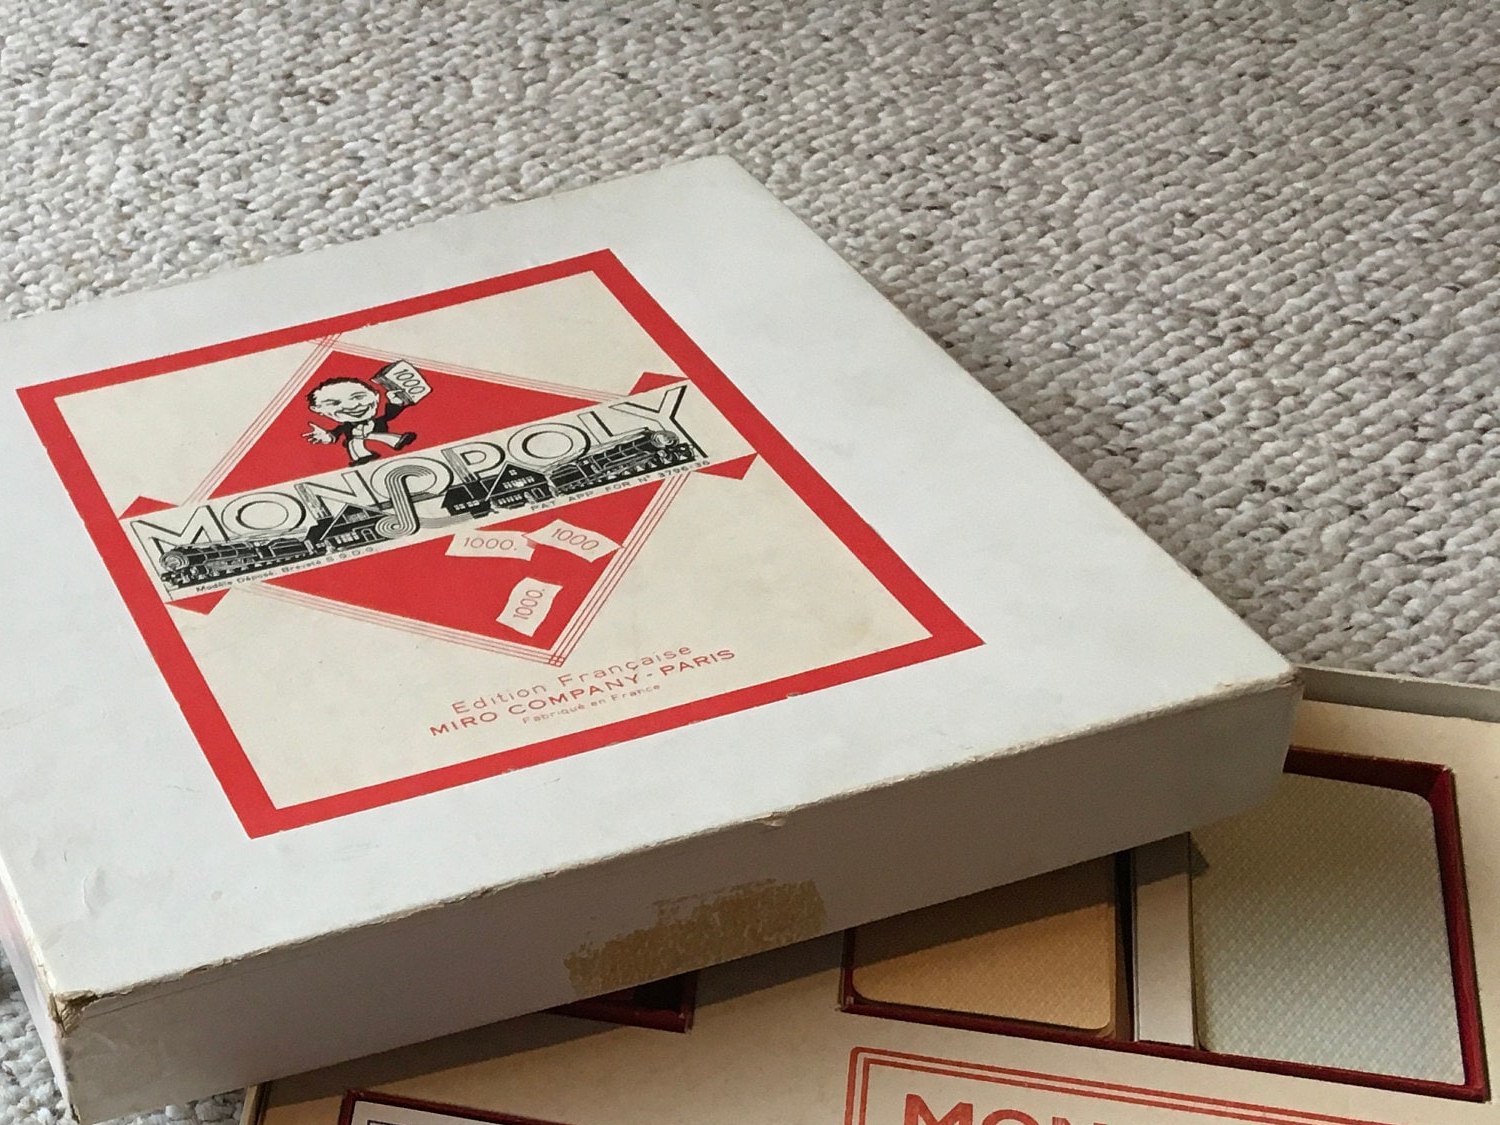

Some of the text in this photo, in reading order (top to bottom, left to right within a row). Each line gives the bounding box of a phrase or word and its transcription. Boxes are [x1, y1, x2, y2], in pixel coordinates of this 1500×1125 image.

[130, 384, 708, 601] MONOPOLY
[429, 650, 735, 736] MIRO COMPANY PARIS
[557, 647, 692, 687] Française
